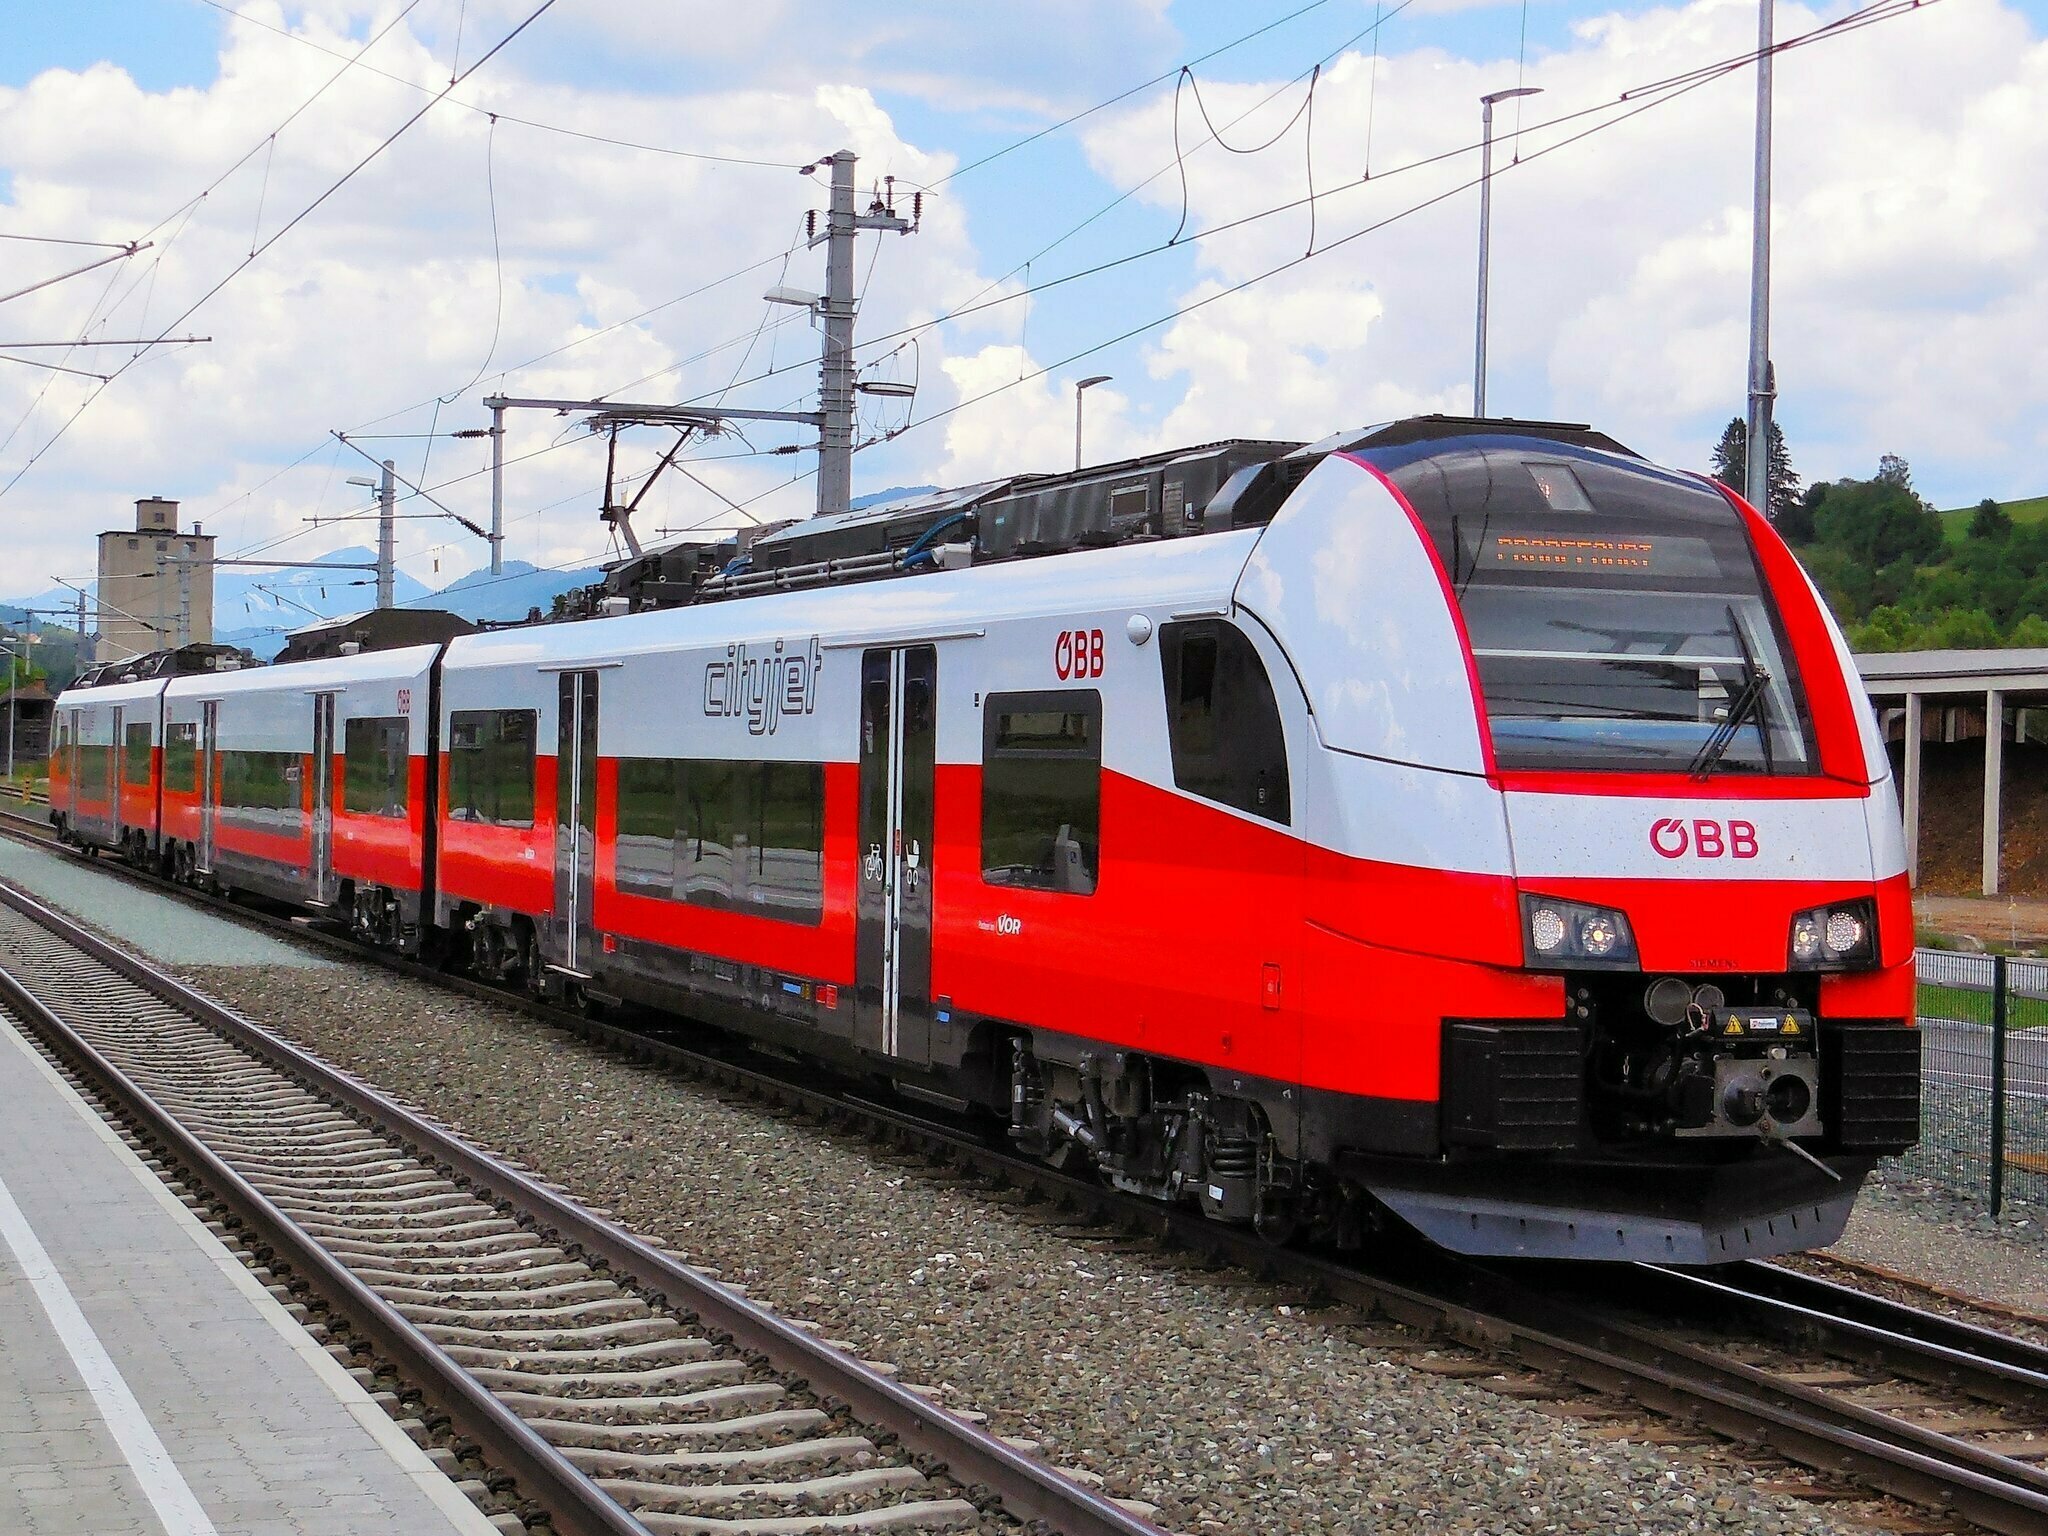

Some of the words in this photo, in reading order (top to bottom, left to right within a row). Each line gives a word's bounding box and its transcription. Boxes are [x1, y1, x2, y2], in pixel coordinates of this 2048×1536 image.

[703, 635, 822, 736] cityjet
[996, 913, 1021, 936] VOR
[1689, 958, 1738, 969] SIEMENS
